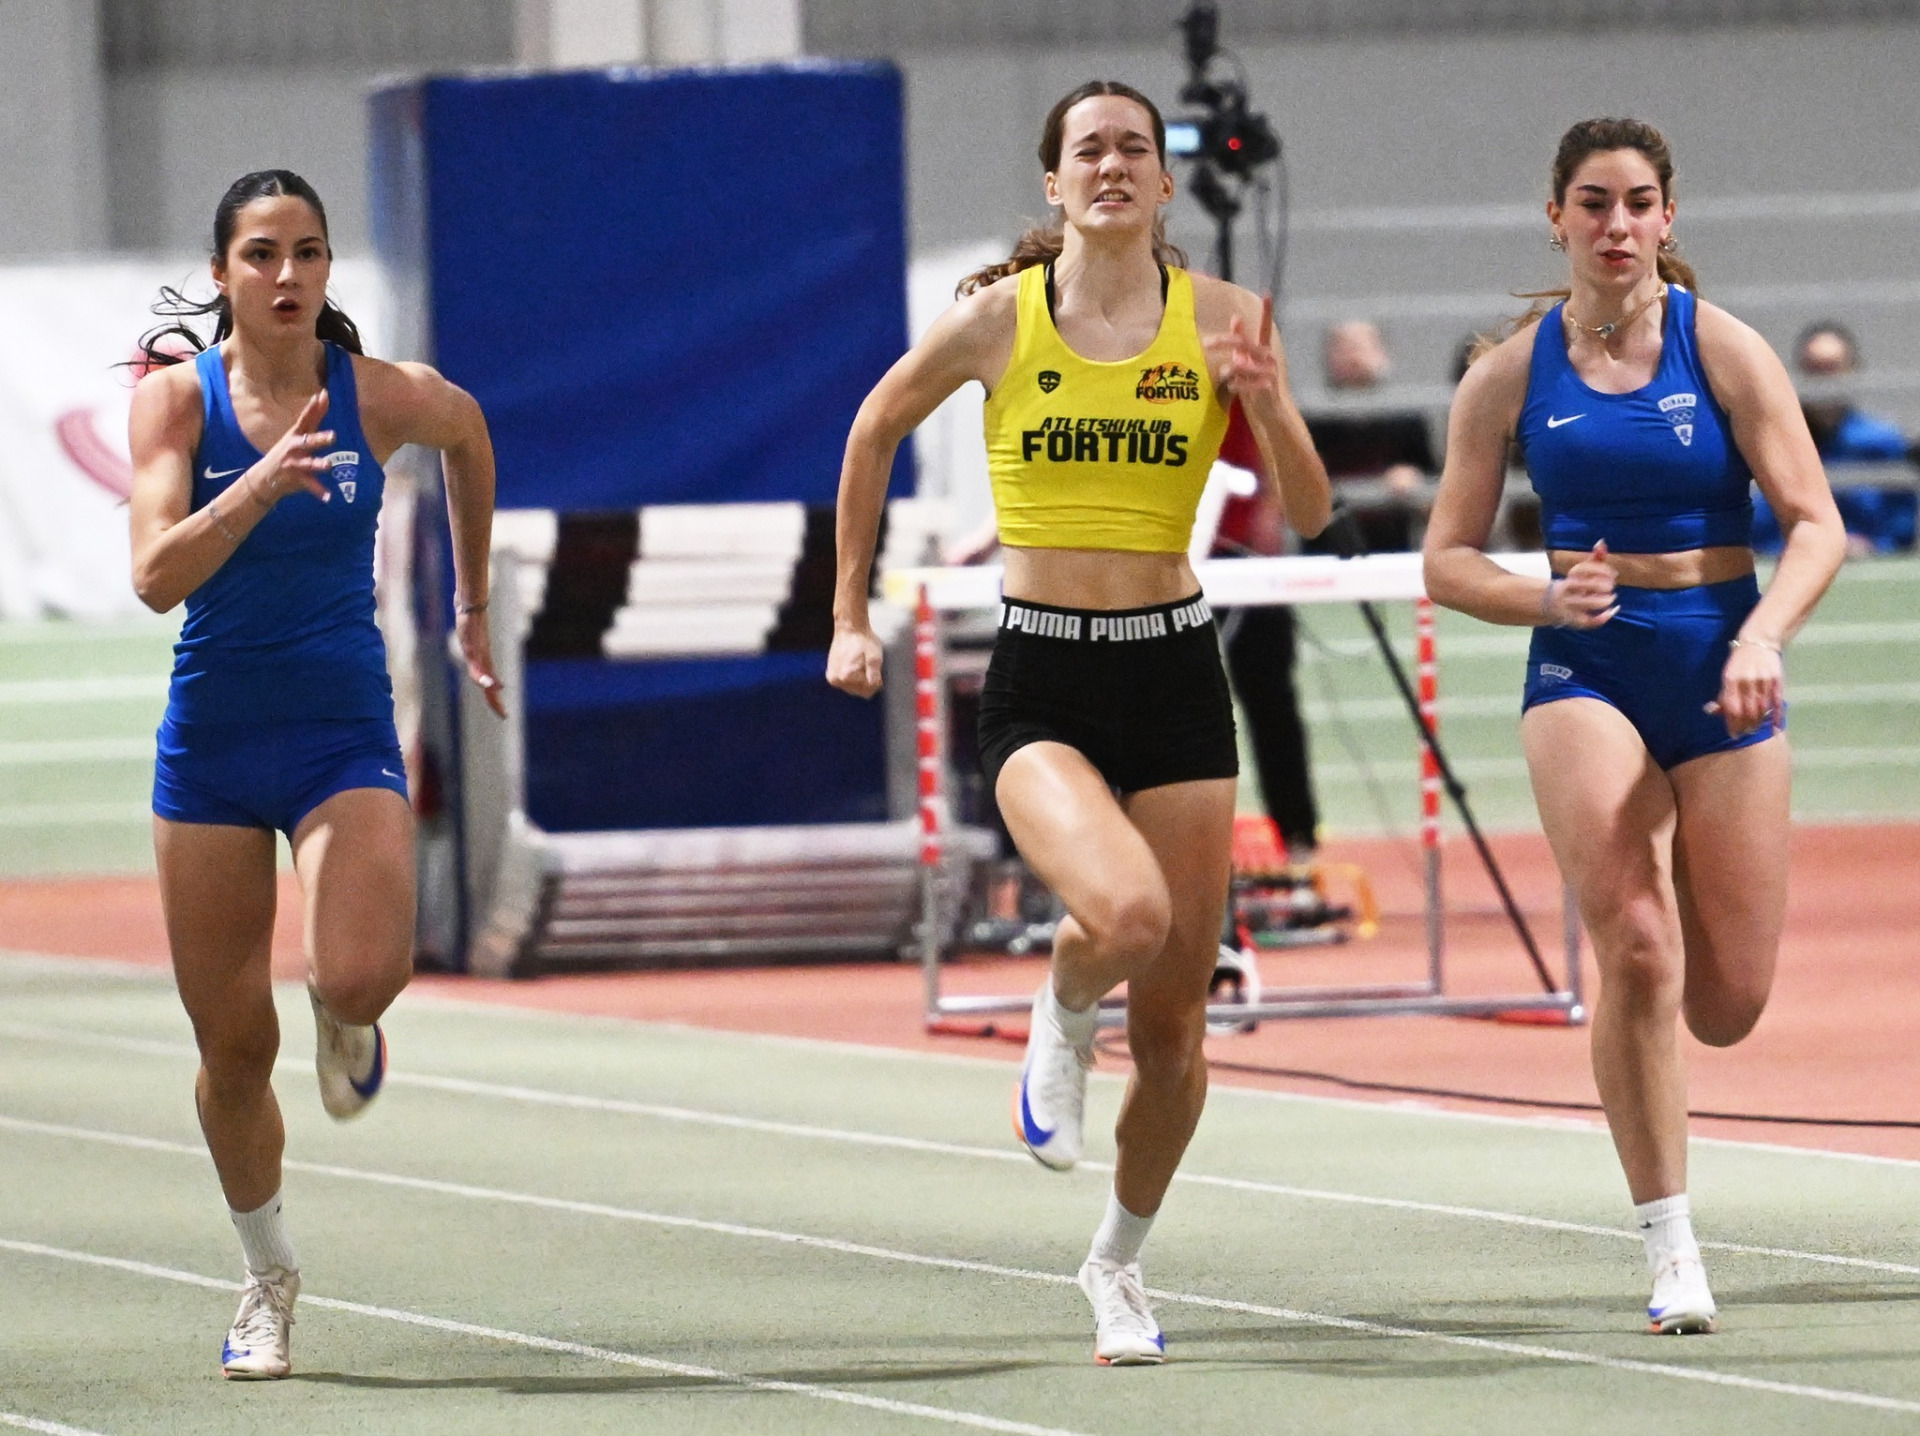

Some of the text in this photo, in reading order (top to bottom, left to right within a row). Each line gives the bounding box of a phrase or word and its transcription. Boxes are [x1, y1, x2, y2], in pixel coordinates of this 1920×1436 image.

[1136, 386, 1199, 401] FORTIUS
[1041, 417, 1172, 433] ATLETSKI KLUB
[1022, 430, 1189, 467] FORTIUS
[1006, 606, 1082, 640] PUMA
[1090, 612, 1167, 641] PUMA
